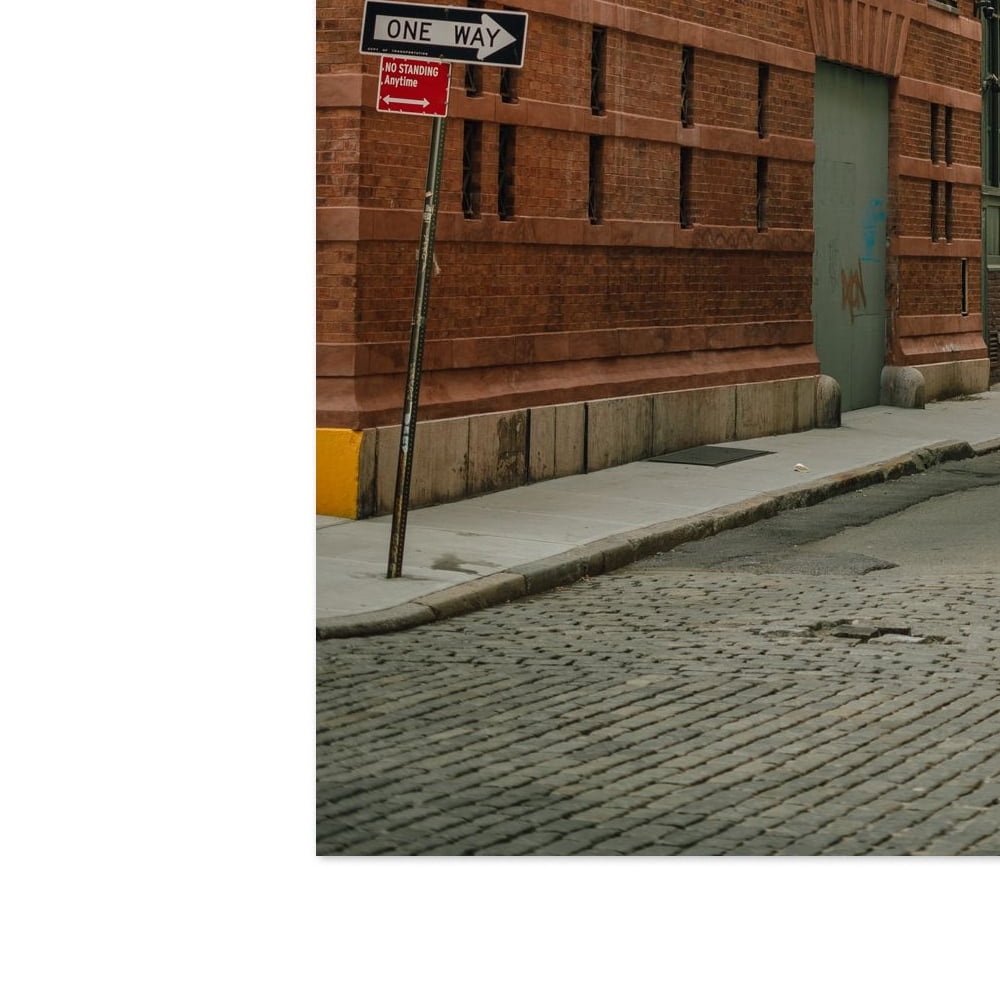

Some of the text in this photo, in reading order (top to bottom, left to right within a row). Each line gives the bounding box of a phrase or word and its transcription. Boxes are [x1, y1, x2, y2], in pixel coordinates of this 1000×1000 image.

[387, 19, 501, 47] ONE WAY
[385, 62, 439, 77] NO STANDING
[384, 74, 418, 88] Anytime
